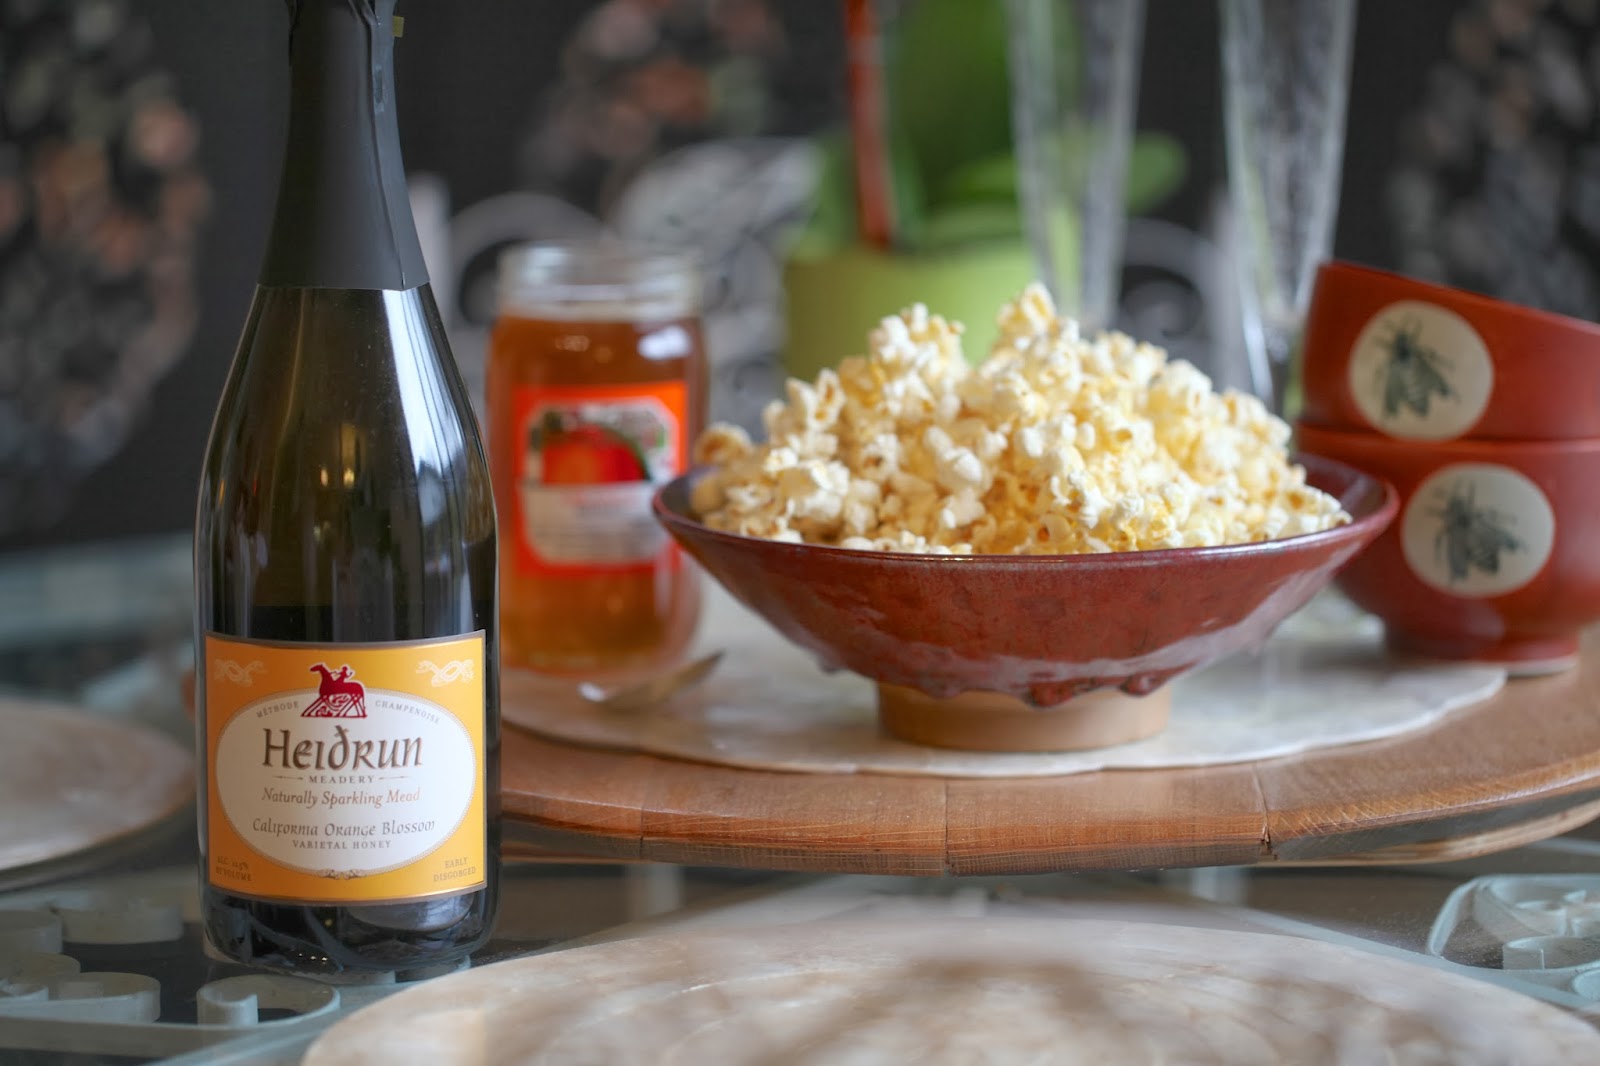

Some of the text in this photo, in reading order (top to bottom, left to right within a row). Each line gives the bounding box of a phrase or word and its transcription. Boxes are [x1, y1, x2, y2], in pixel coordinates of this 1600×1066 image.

[375, 700, 440, 724] CHAMPENOISE
[308, 775, 375, 784] MEADERY
[261, 787, 421, 809] Naturally Sparkling Mead
[252, 818, 435, 839] California Orange Blossom
[292, 839, 391, 849] VARIETAL HONEY
[444, 856, 468, 869] EARLY
[223, 868, 252, 882] VOLUME
[433, 866, 476, 881] DISGORGED
